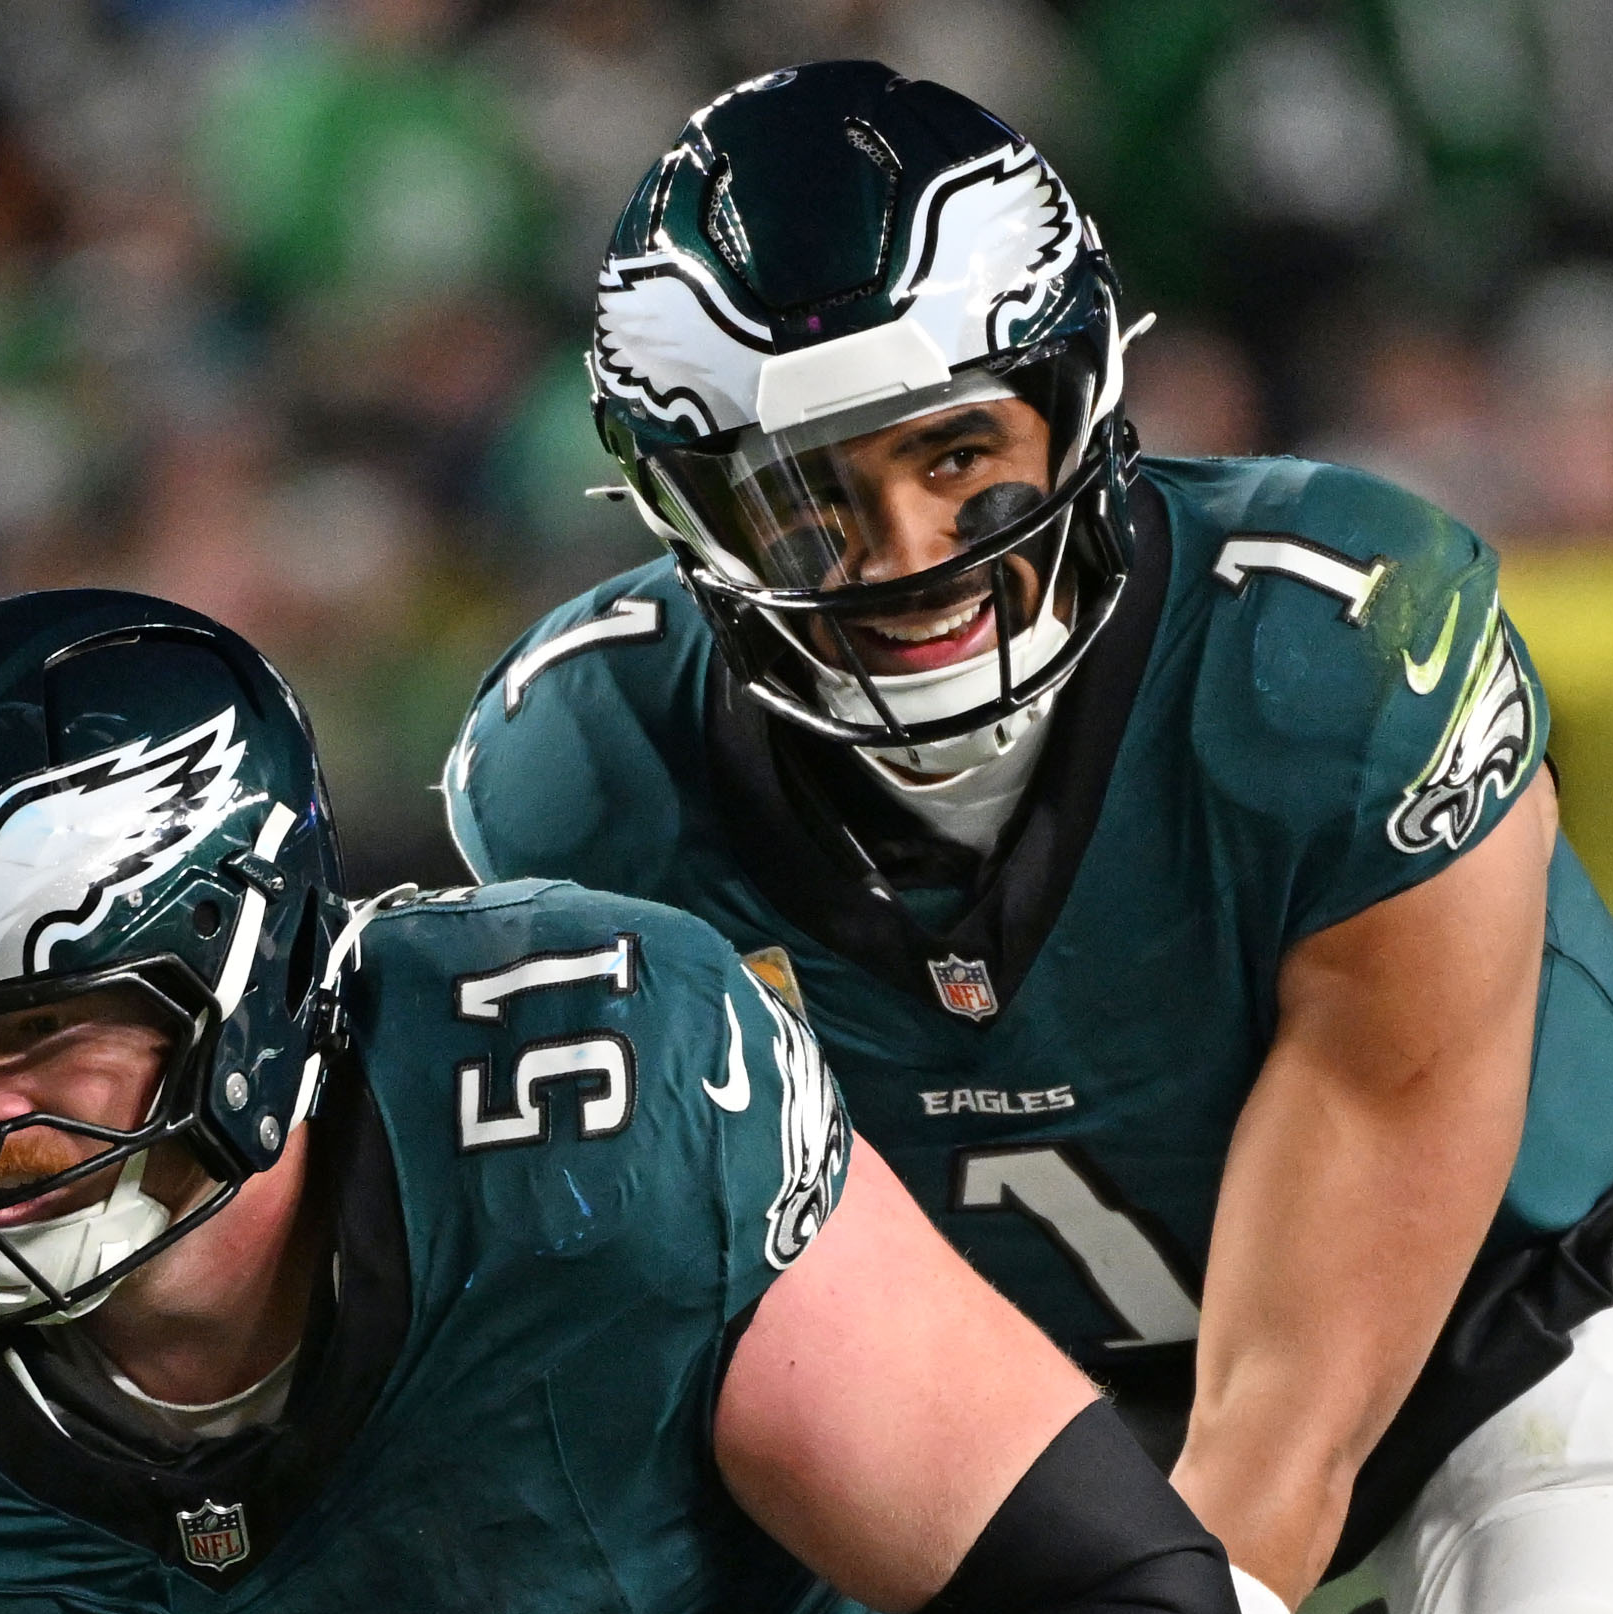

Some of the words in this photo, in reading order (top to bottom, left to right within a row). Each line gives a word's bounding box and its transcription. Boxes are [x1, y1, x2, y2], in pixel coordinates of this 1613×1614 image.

[1214, 533, 1392, 628] 1
[505, 597, 663, 719] 1
[457, 934, 636, 1152] 51
[944, 983, 990, 1010] NFL
[918, 1085, 1076, 1116] EAGLES
[962, 1146, 1202, 1349] 1
[191, 1531, 241, 1561] NFL
